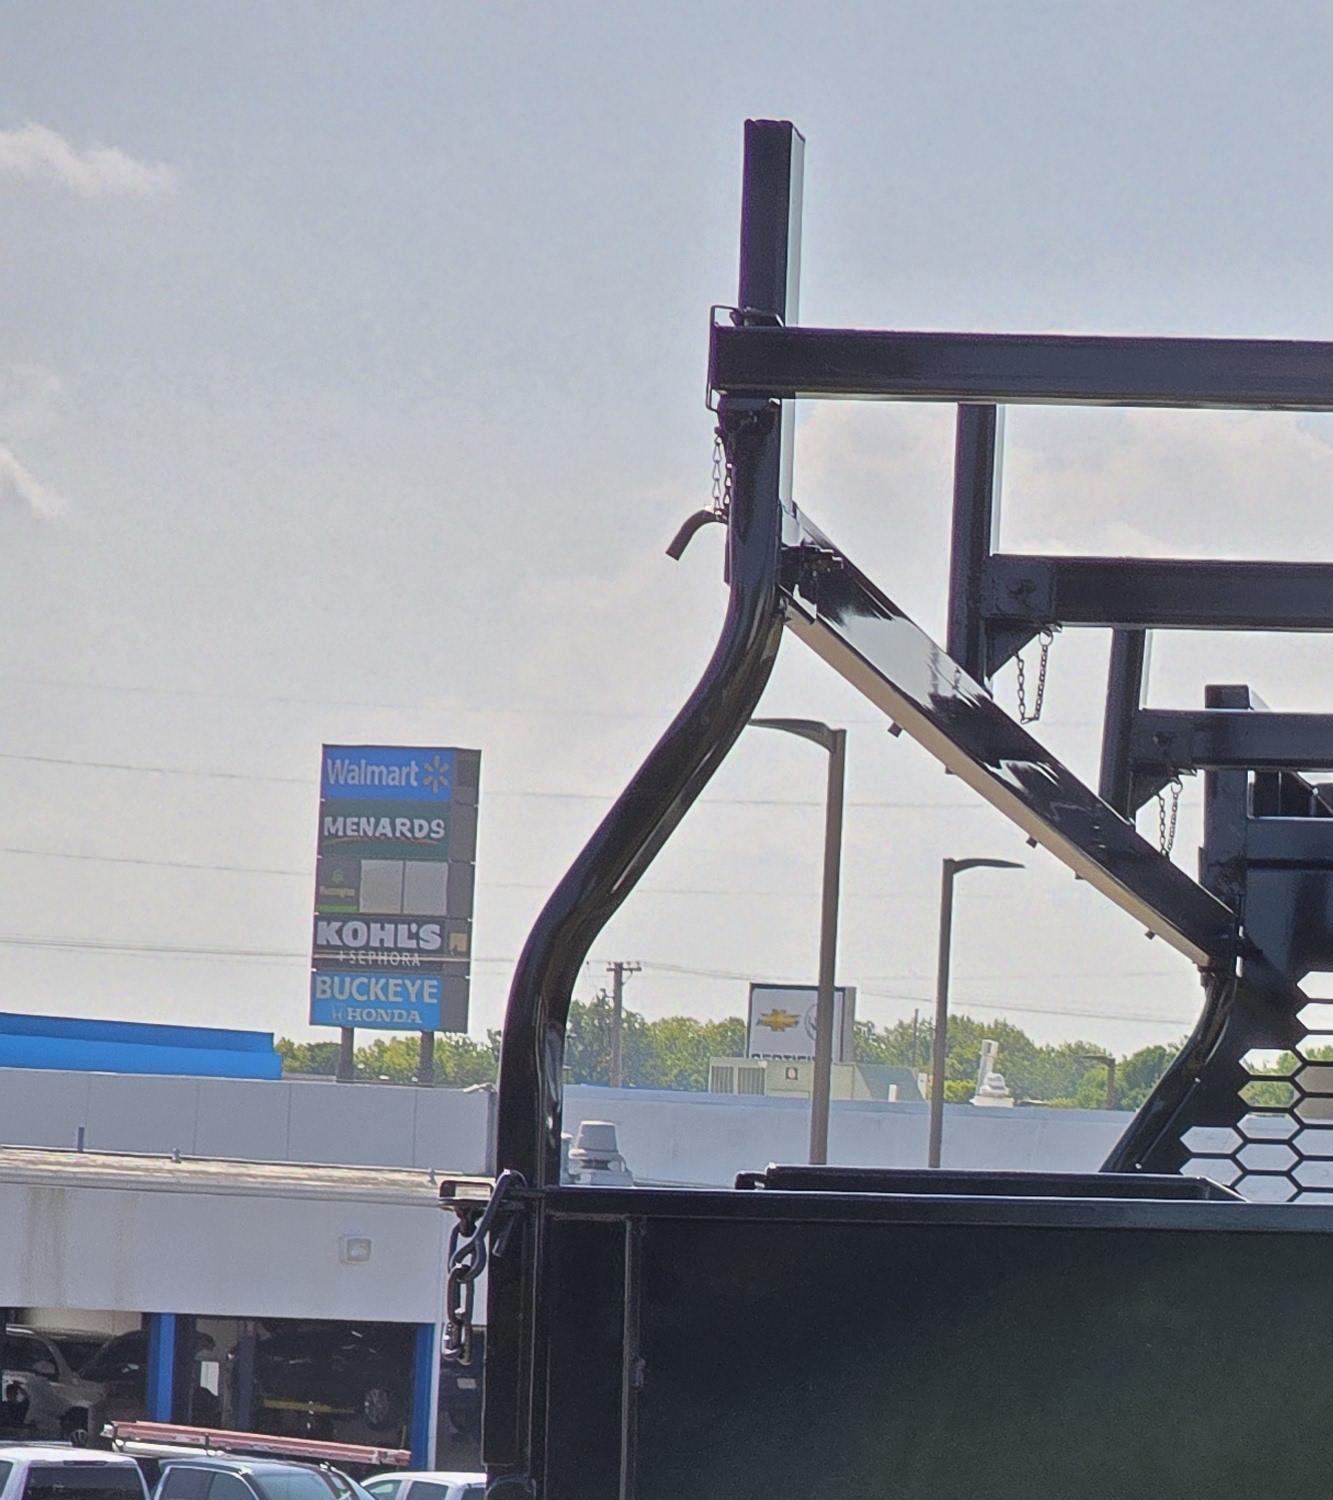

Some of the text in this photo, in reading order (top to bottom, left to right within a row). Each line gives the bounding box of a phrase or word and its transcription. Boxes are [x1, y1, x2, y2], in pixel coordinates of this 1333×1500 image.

[327, 758, 420, 787] Walmart
[323, 816, 445, 839] MENARDS
[317, 921, 441, 950] KOHL'S
[349, 951, 420, 966] SEPHORA
[316, 976, 438, 1003] BUCKEYE
[347, 1008, 423, 1023] HONDA
